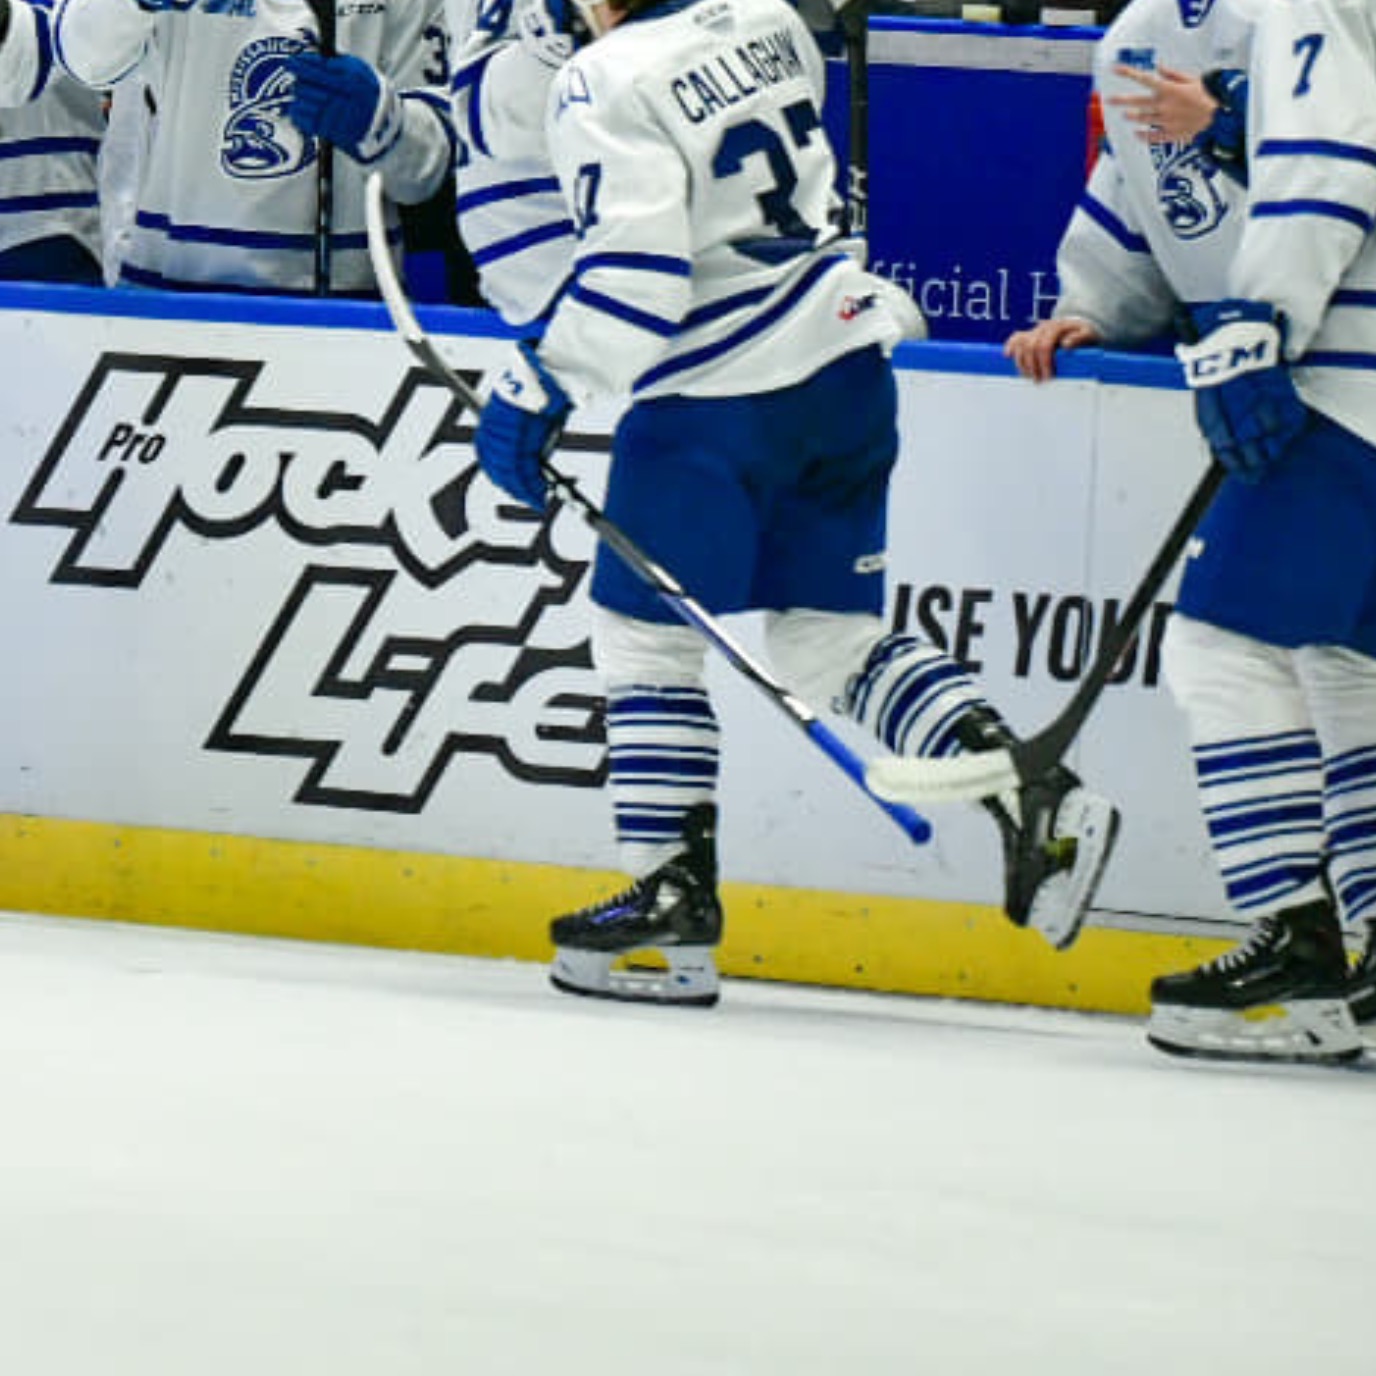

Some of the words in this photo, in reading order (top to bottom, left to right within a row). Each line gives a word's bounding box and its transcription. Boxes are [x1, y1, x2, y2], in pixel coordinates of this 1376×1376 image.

[1292, 34, 1325, 98] 7
[8, 352, 598, 604] Hocke
[98, 423, 166, 465] Pro
[202, 563, 610, 814] Life
